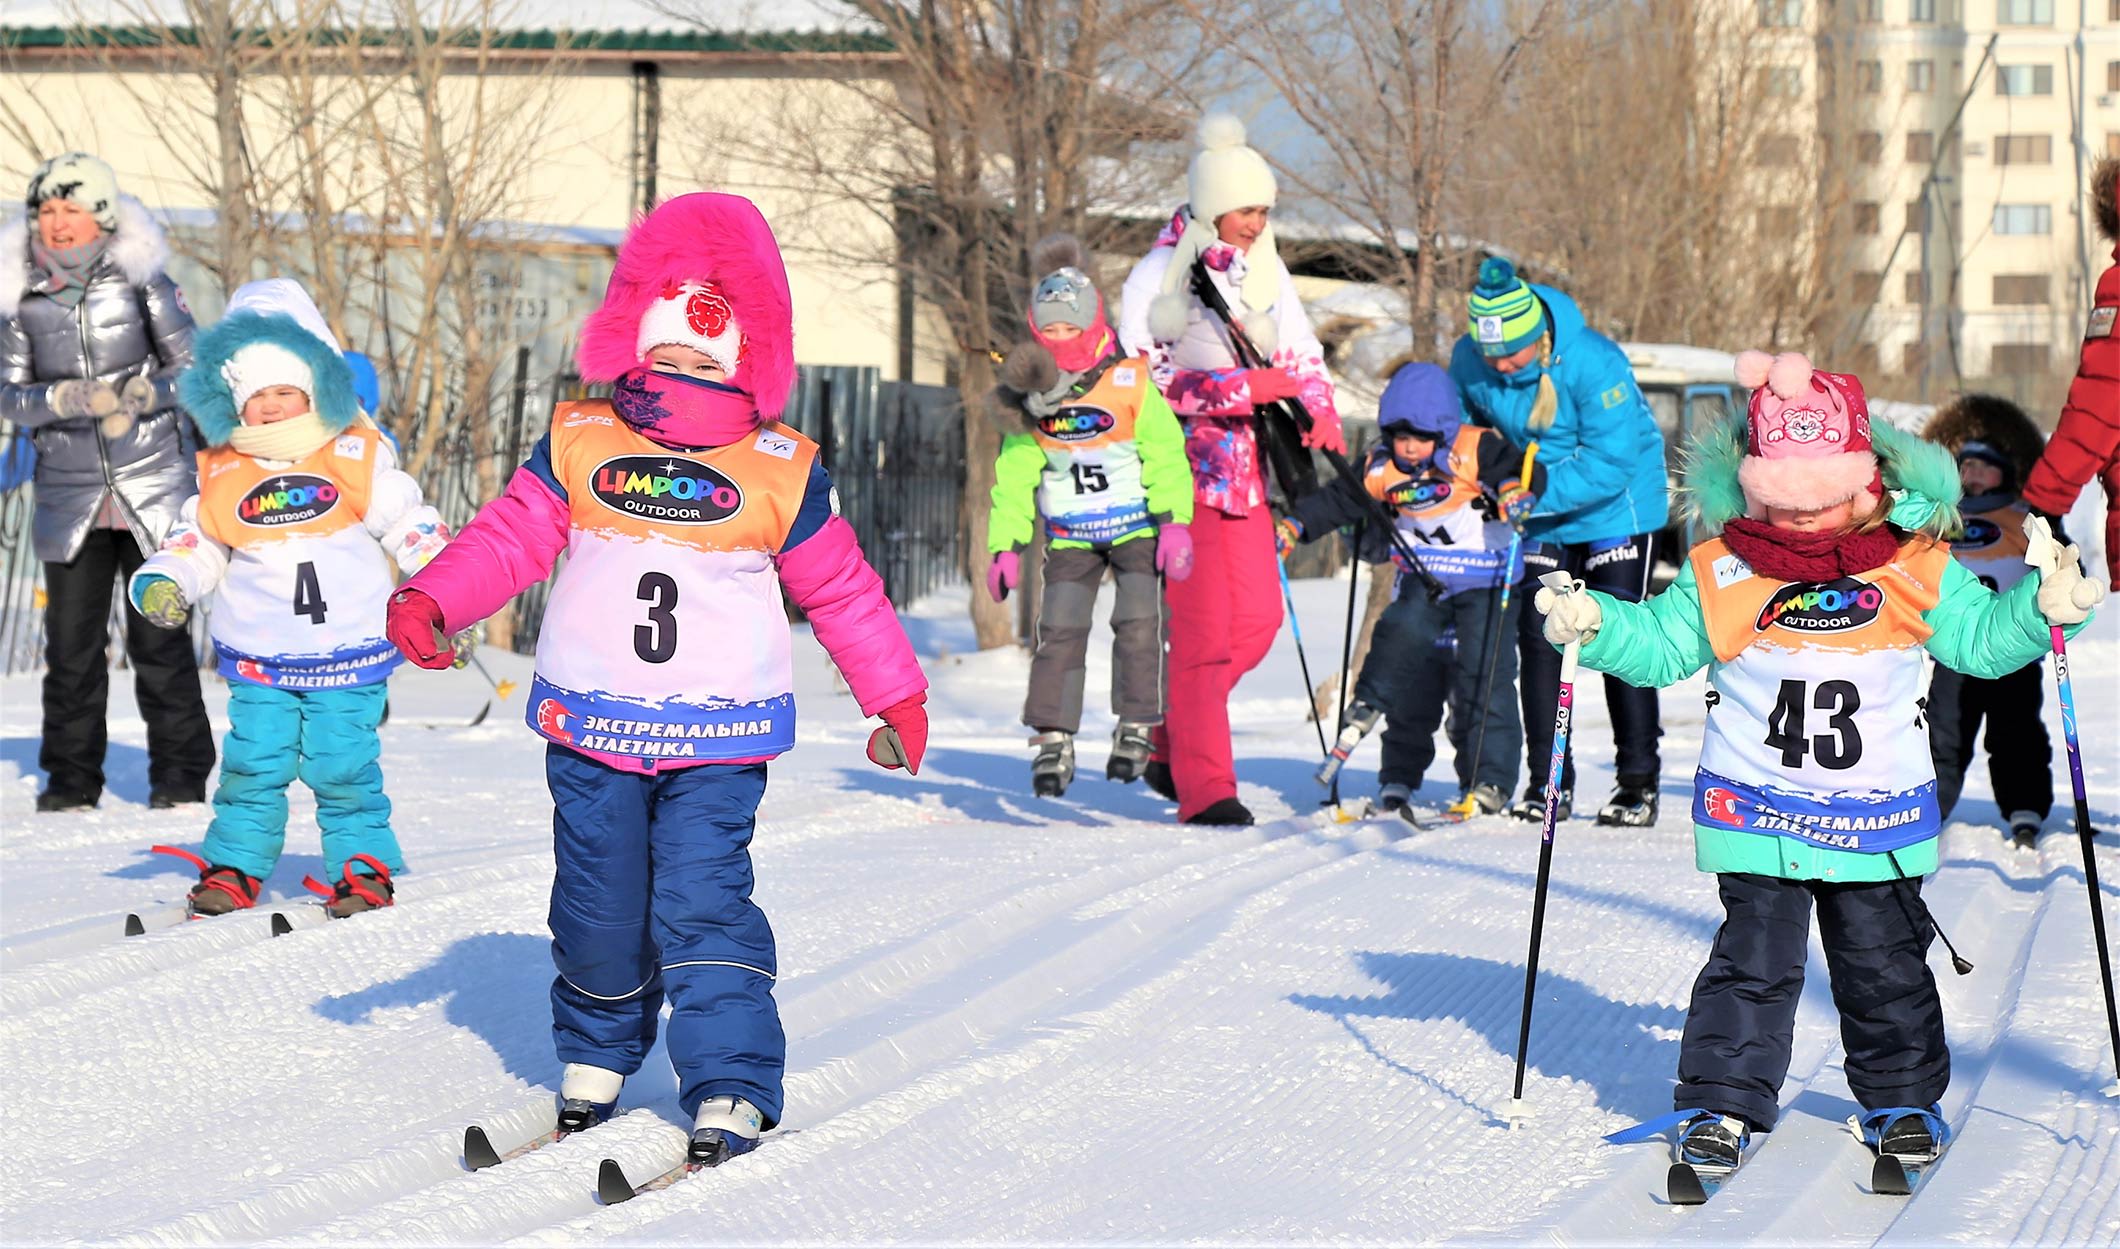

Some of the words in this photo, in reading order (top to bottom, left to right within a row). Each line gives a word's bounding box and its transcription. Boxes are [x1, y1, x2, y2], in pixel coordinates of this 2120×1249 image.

[598, 468, 739, 509] LIMPOPO
[1070, 463, 1109, 494] 15
[241, 484, 338, 519] LIMPOPO
[262, 508, 317, 524] OUTDOOR
[624, 500, 701, 519] OUTDOOR
[294, 561, 327, 625] 4
[1759, 589, 1881, 627] LIMPOPO
[634, 572, 678, 664] 3
[1784, 616, 1852, 628] OUTDOOR
[278, 672, 359, 688] АТЛЕТИКА
[582, 715, 773, 738] ЭКСТРЕМАЛЬНАЯ
[1764, 679, 1863, 770] 43
[579, 734, 696, 757] АТЛЕТИКА
[1752, 815, 1860, 849] АТЛЕТИКА
